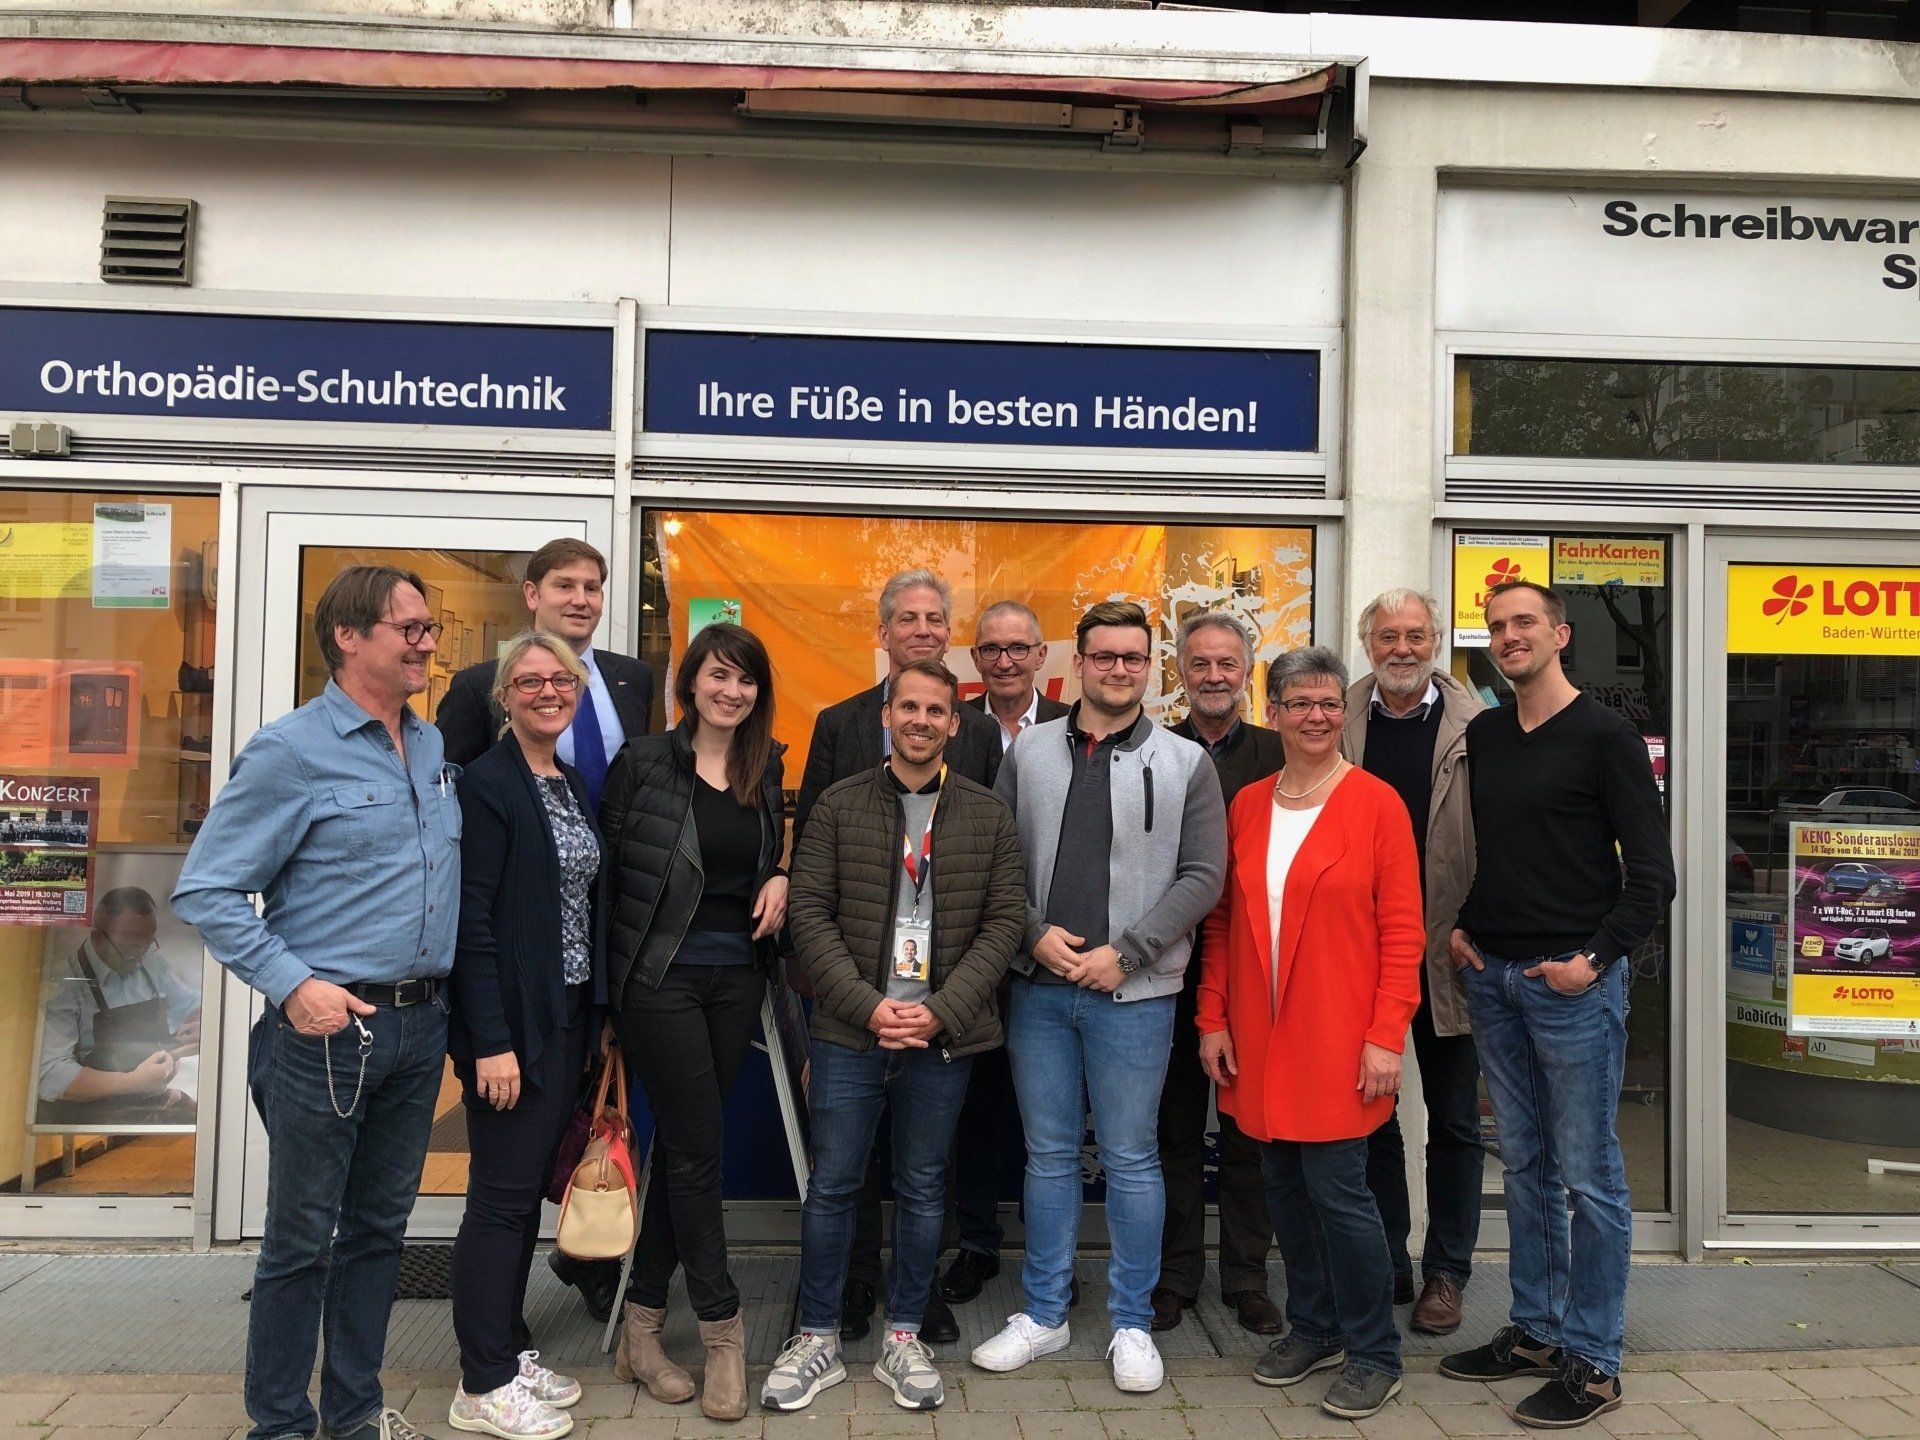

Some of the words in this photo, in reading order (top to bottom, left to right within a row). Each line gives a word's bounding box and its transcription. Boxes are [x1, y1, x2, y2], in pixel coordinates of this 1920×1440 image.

[1603, 200, 1920, 244] Schreibwar
[1882, 253, 1920, 301] S
[40, 359, 566, 412] Orthopädie-Schuhtechnik
[698, 382, 774, 419] Ihre
[790, 383, 883, 422] Füße
[898, 389, 932, 424] in
[948, 390, 1078, 429] besten
[1095, 395, 1258, 433] Händen!
[1558, 541, 1660, 560] FahrKarten
[0, 779, 91, 803] KONZERT
[1811, 845, 1818, 853] 14
[1820, 845, 1835, 855] Tage
[1853, 846, 1863, 855] 06.
[1866, 847, 1875, 855] bis
[1877, 847, 1887, 856] 19.
[1889, 848, 1901, 856] Mai
[1903, 848, 1919, 857] 2019
[1823, 906, 1834, 915] VW
[1835, 907, 1854, 916] T-Roc,
[1866, 908, 1884, 916] smart
[1886, 908, 1894, 917] EQ
[1895, 909, 1916, 917] fortwo
[1740, 944, 1763, 957] NIL
[1852, 987, 1894, 1000] LOTTO
[1811, 1041, 1826, 1052] AD
